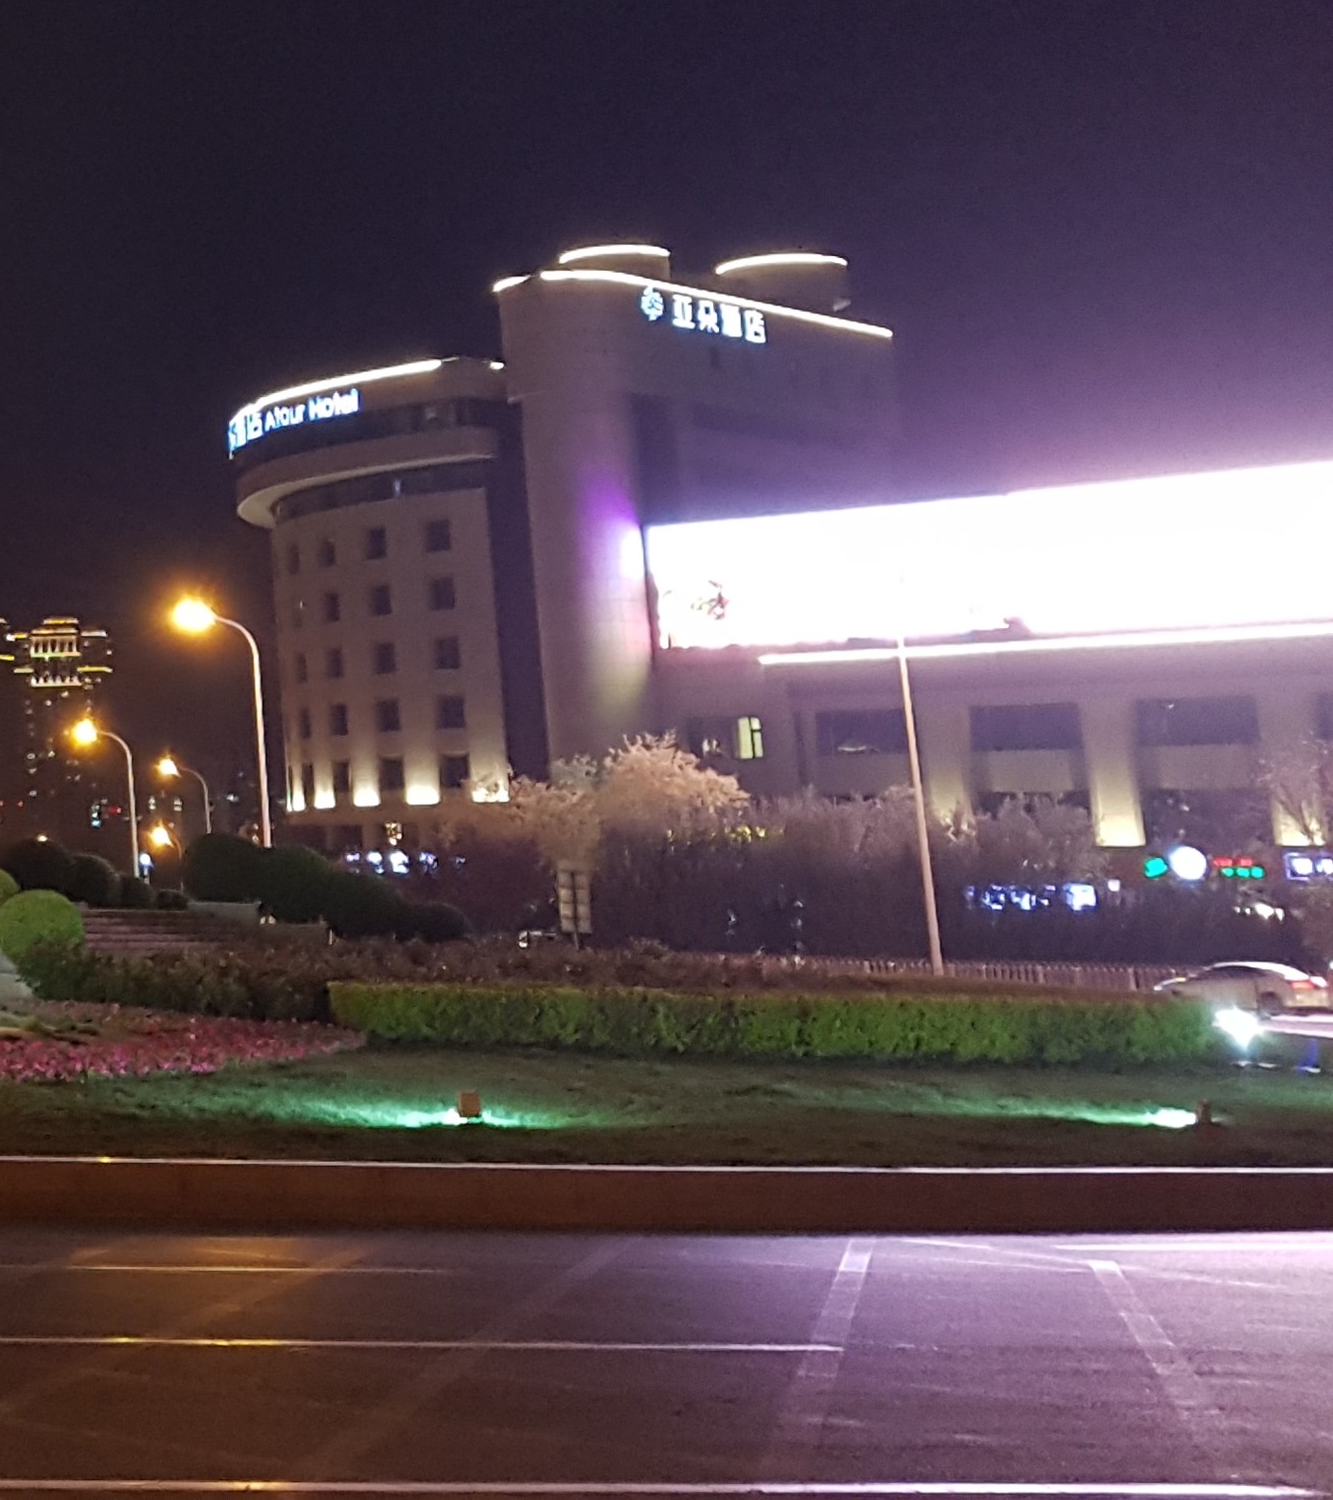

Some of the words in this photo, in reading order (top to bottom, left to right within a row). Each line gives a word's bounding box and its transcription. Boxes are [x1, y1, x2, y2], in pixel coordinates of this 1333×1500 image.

[672, 293, 766, 344] 亚朵酒店
[307, 388, 359, 421] Hotel
